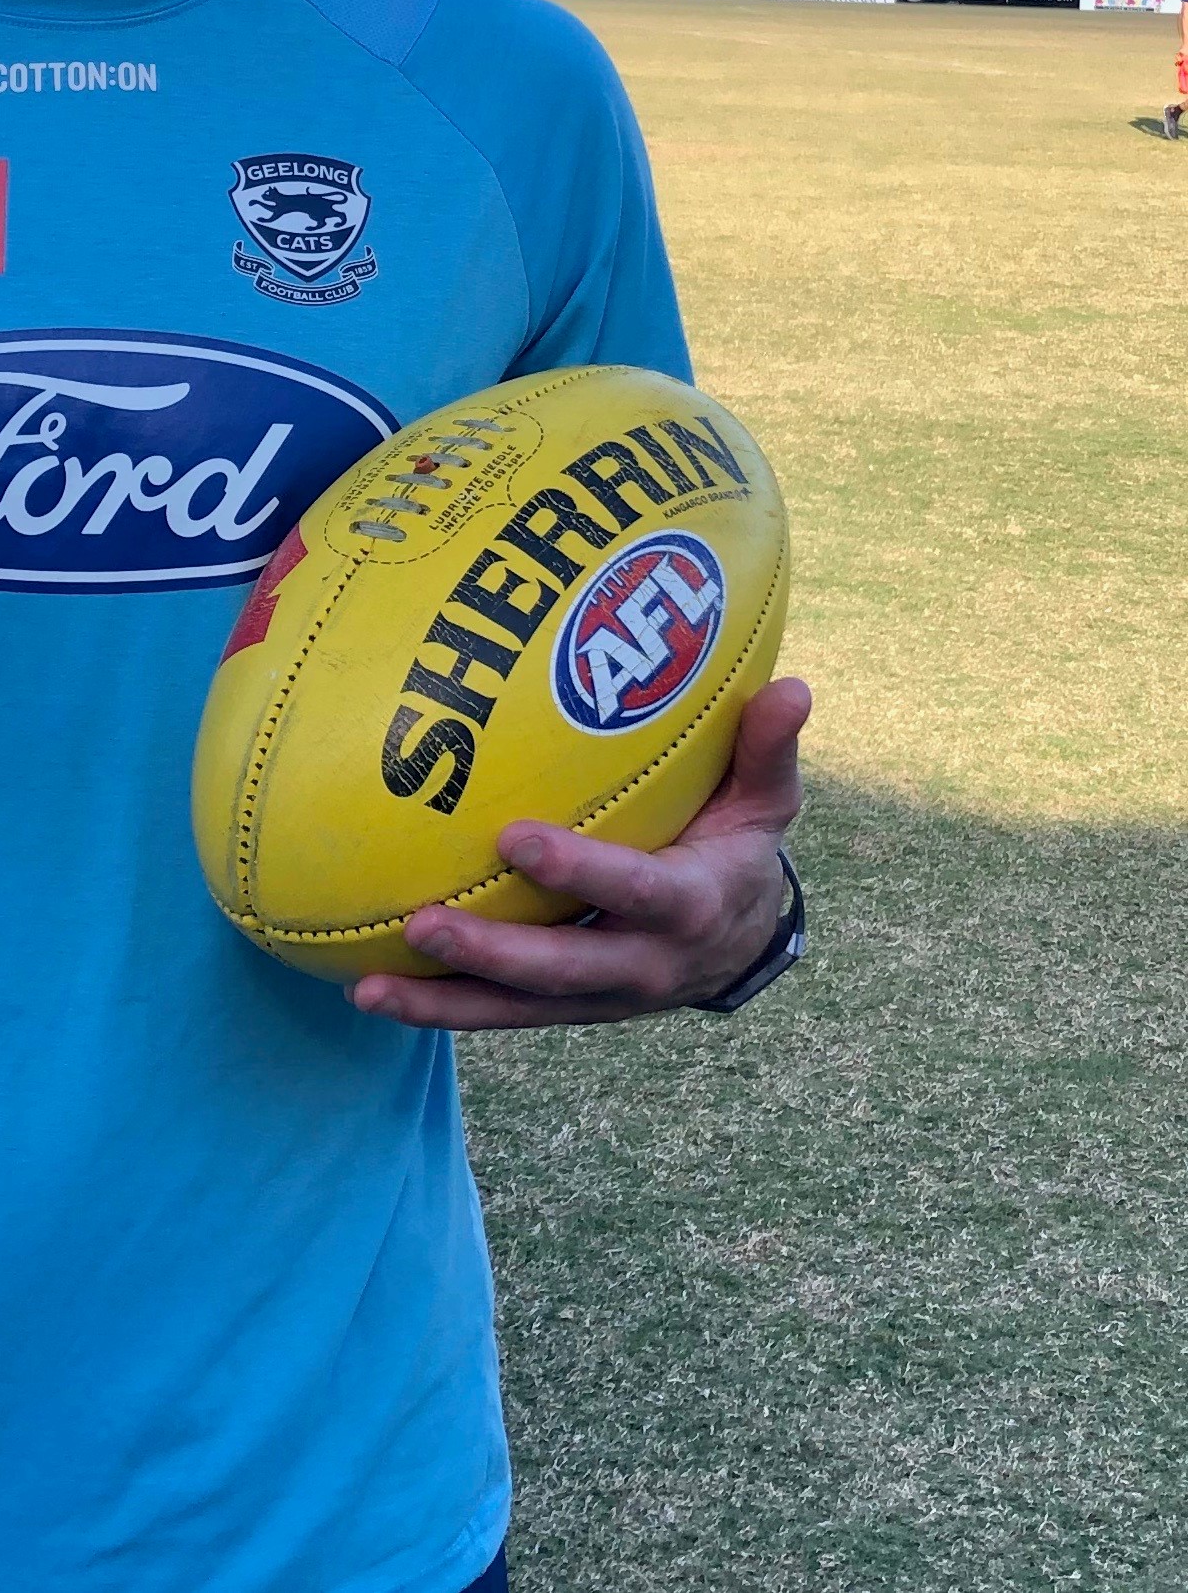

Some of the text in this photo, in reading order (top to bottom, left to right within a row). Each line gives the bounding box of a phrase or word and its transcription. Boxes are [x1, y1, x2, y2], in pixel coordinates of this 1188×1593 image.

[246, 161, 350, 185] GEELONG
[276, 234, 333, 251] CATS
[239, 259, 258, 270] EST
[260, 280, 355, 301] FOOTBALL CLUB
[429, 444, 517, 530] LUBRICATE NEEDLE
[440, 494, 482, 534] INFLATE
[479, 480, 495, 493] TO
[662, 495, 709, 520] KANGAROO
[380, 415, 751, 816] SHERRIN
[576, 553, 721, 725] AFL
